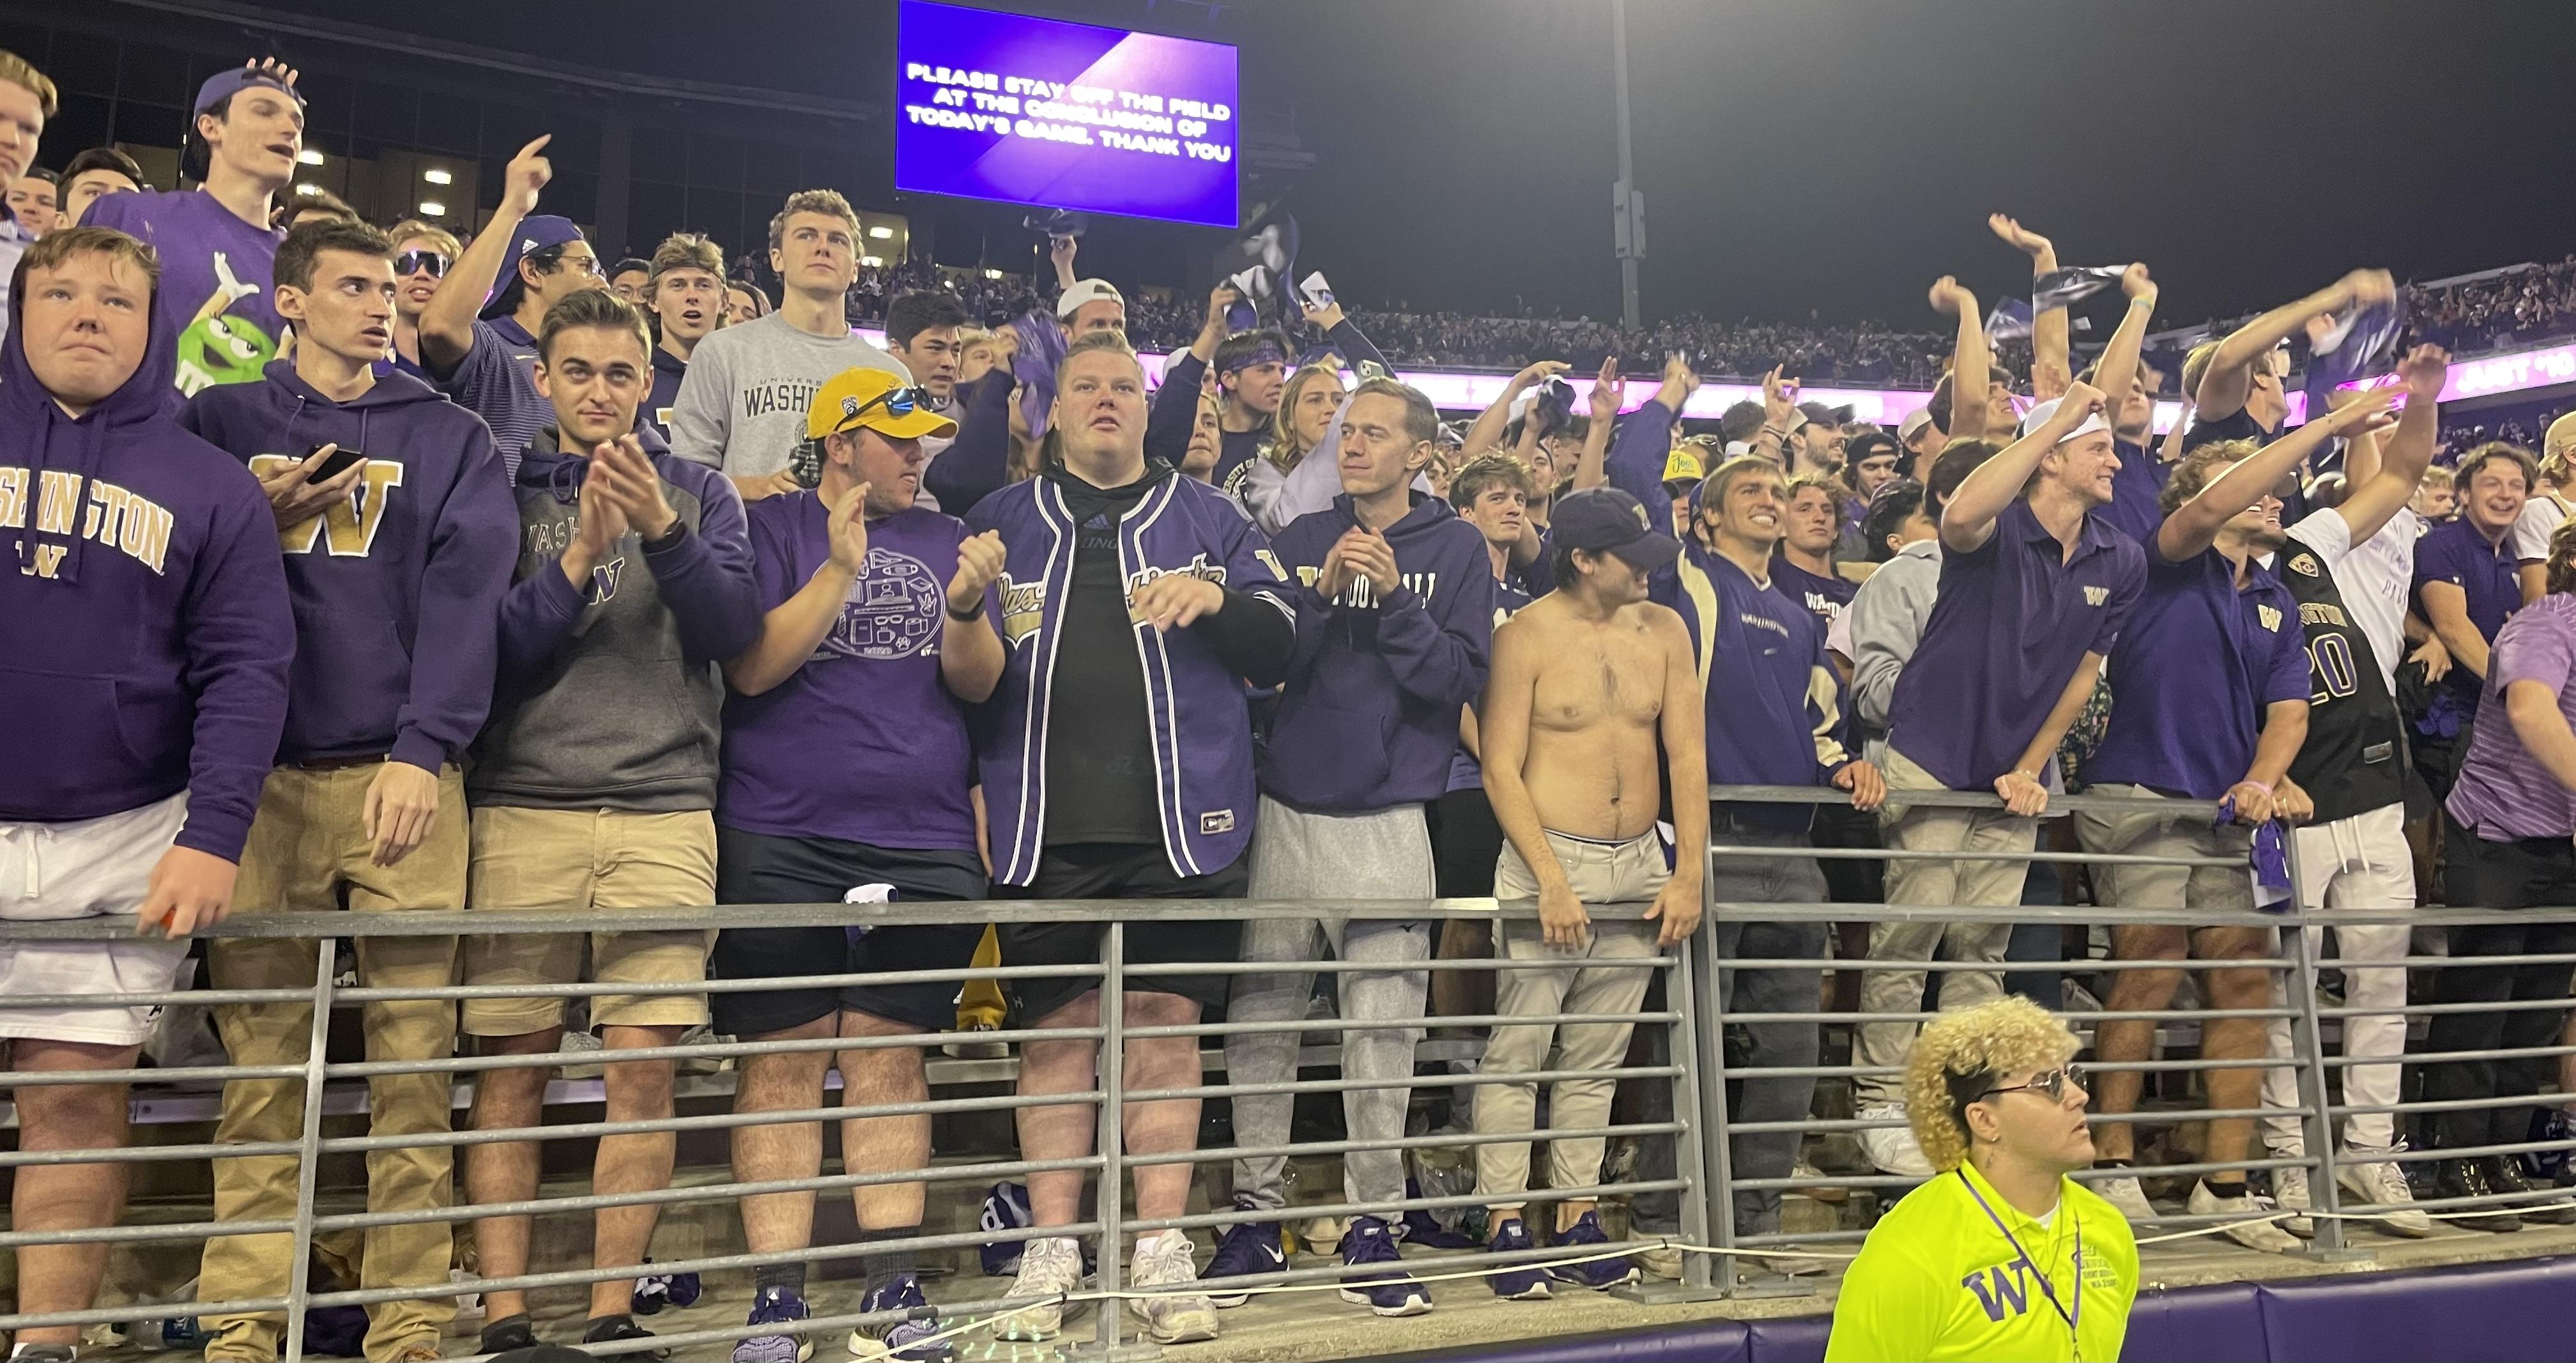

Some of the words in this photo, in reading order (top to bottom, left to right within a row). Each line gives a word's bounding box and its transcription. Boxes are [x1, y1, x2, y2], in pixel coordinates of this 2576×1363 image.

[907, 63, 999, 91] PLEASE
[1004, 76, 1065, 99] STAY
[1070, 84, 1114, 105] OFF
[1119, 91, 1163, 112] THE
[1169, 98, 1230, 121] FIELD
[933, 88, 968, 107] AT
[972, 92, 1019, 114] THE
[1025, 99, 1173, 134] CONCLUSION
[1177, 119, 1207, 137] OF
[906, 105, 1011, 135] TODAY'S
[1015, 119, 1094, 146] GAME.
[1099, 130, 1180, 156] THANK
[1184, 141, 1231, 162] YOU
[744, 384, 820, 418] WASHI
[2083, 585, 2110, 606] W
[2258, 604, 2283, 633] W
[1962, 1258, 2032, 1322] W
